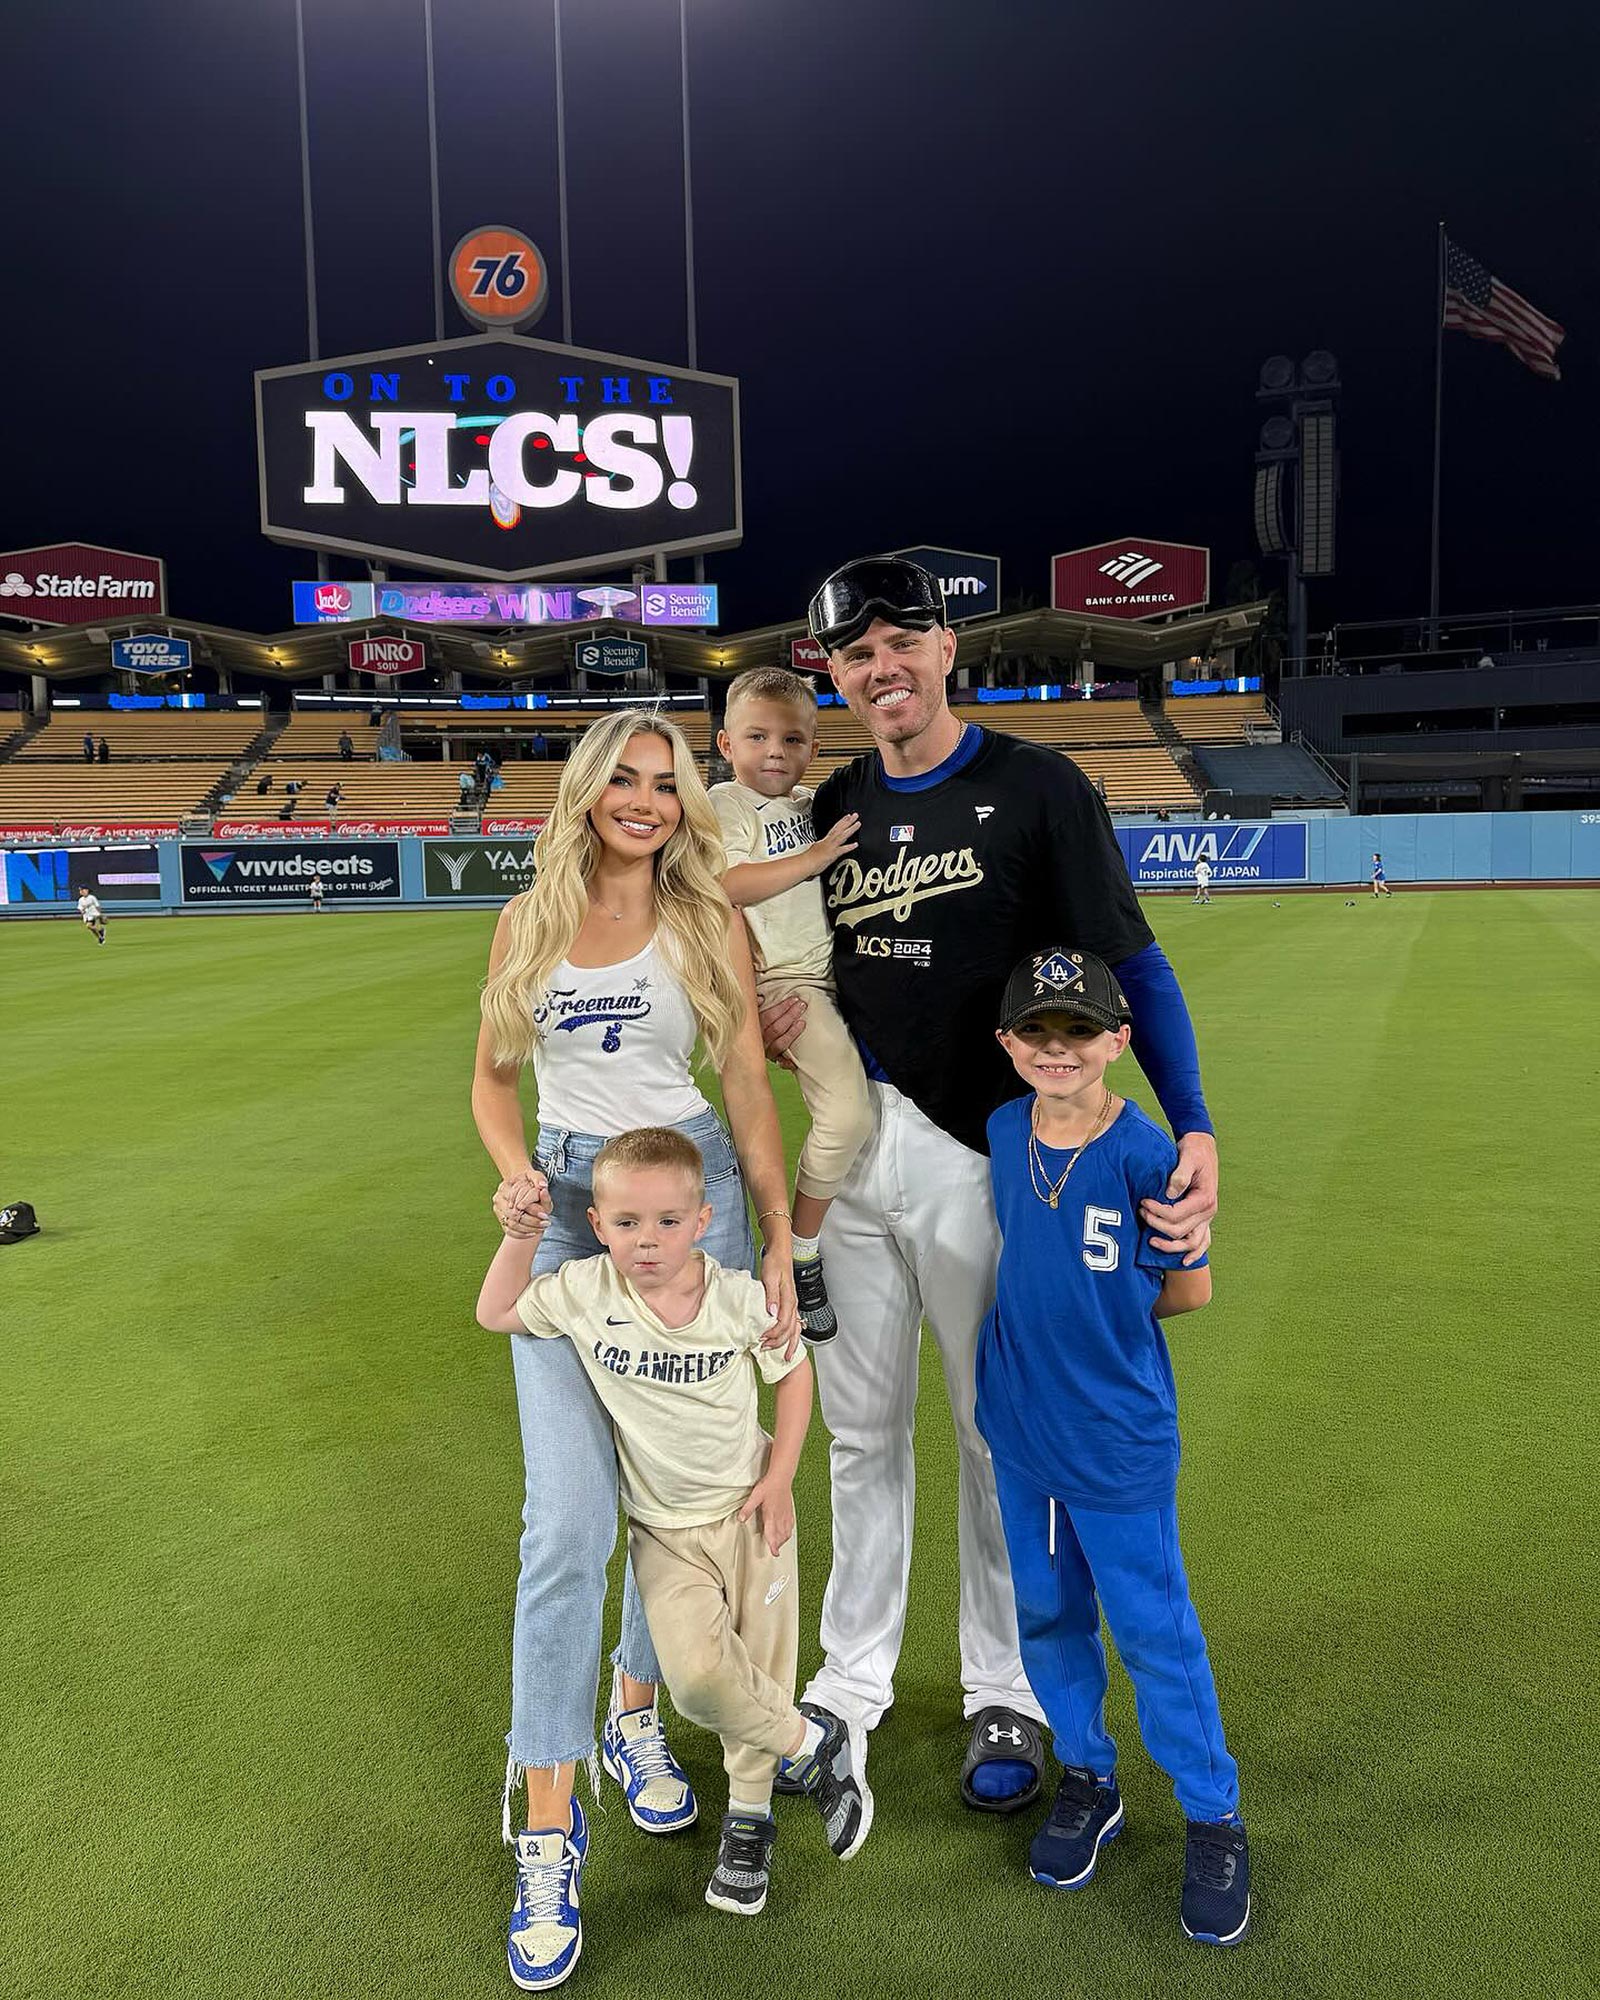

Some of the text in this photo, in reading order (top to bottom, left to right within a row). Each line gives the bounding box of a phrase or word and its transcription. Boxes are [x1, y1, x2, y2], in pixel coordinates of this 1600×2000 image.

[469, 252, 526, 297] 76
[323, 372, 673, 404] ON TO THE
[303, 410, 698, 510] NLCS!
[938, 577, 978, 596] um
[317, 588, 351, 610] Jack
[496, 589, 572, 622] WIN!
[669, 593, 712, 606] Security
[1085, 593, 1175, 606] BANK OF AMERICA
[670, 604, 708, 617] Benefit
[122, 643, 169, 654] TOYO
[362, 643, 413, 666] JINRO
[602, 646, 641, 657] Security
[130, 655, 181, 666] TIRES
[376, 662, 399, 671] SOJU
[603, 656, 635, 666] Benefit
[157, 828, 177, 836] TIME
[1140, 833, 1218, 862] ANA
[236, 854, 373, 877] vividseats
[484, 850, 535, 870] YAA
[0, 850, 70, 904] N!
[1139, 867, 1199, 881] Inspiratio
[1220, 866, 1260, 878] JAPAN
[189, 885, 232, 894] OFFICIAL
[234, 884, 266, 893] TICKET
[269, 883, 333, 892] MARKETPCE
[336, 883, 348, 891] OF
[350, 882, 367, 891] THE
[828, 846, 982, 923] Dodgers
[856, 935, 931, 957] NLCS 2024
[1049, 961, 1068, 981] LA
[1074, 981, 1086, 993] 4
[533, 989, 642, 1024] Freeman
[1083, 1205, 1121, 1272] 5
[593, 1341, 737, 1384] LOS ANGELES
